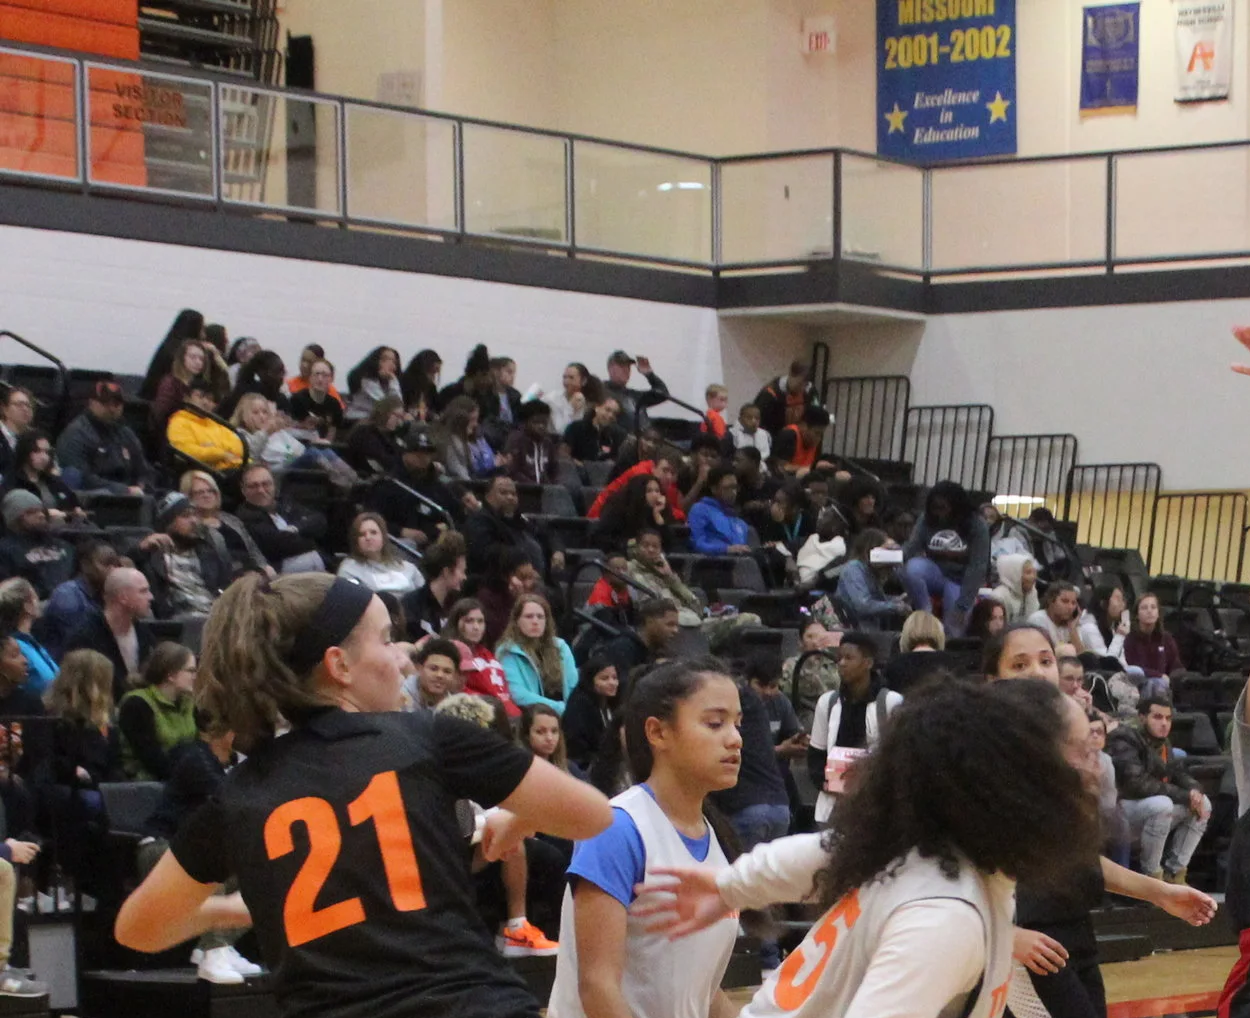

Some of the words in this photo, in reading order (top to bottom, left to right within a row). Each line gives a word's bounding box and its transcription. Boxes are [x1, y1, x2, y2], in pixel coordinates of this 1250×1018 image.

[885, 24, 1011, 69] 2001-2002
[913, 87, 980, 109] Excellence
[940, 108, 953, 124] in
[913, 123, 980, 144] Education
[264, 770, 427, 947] 21
